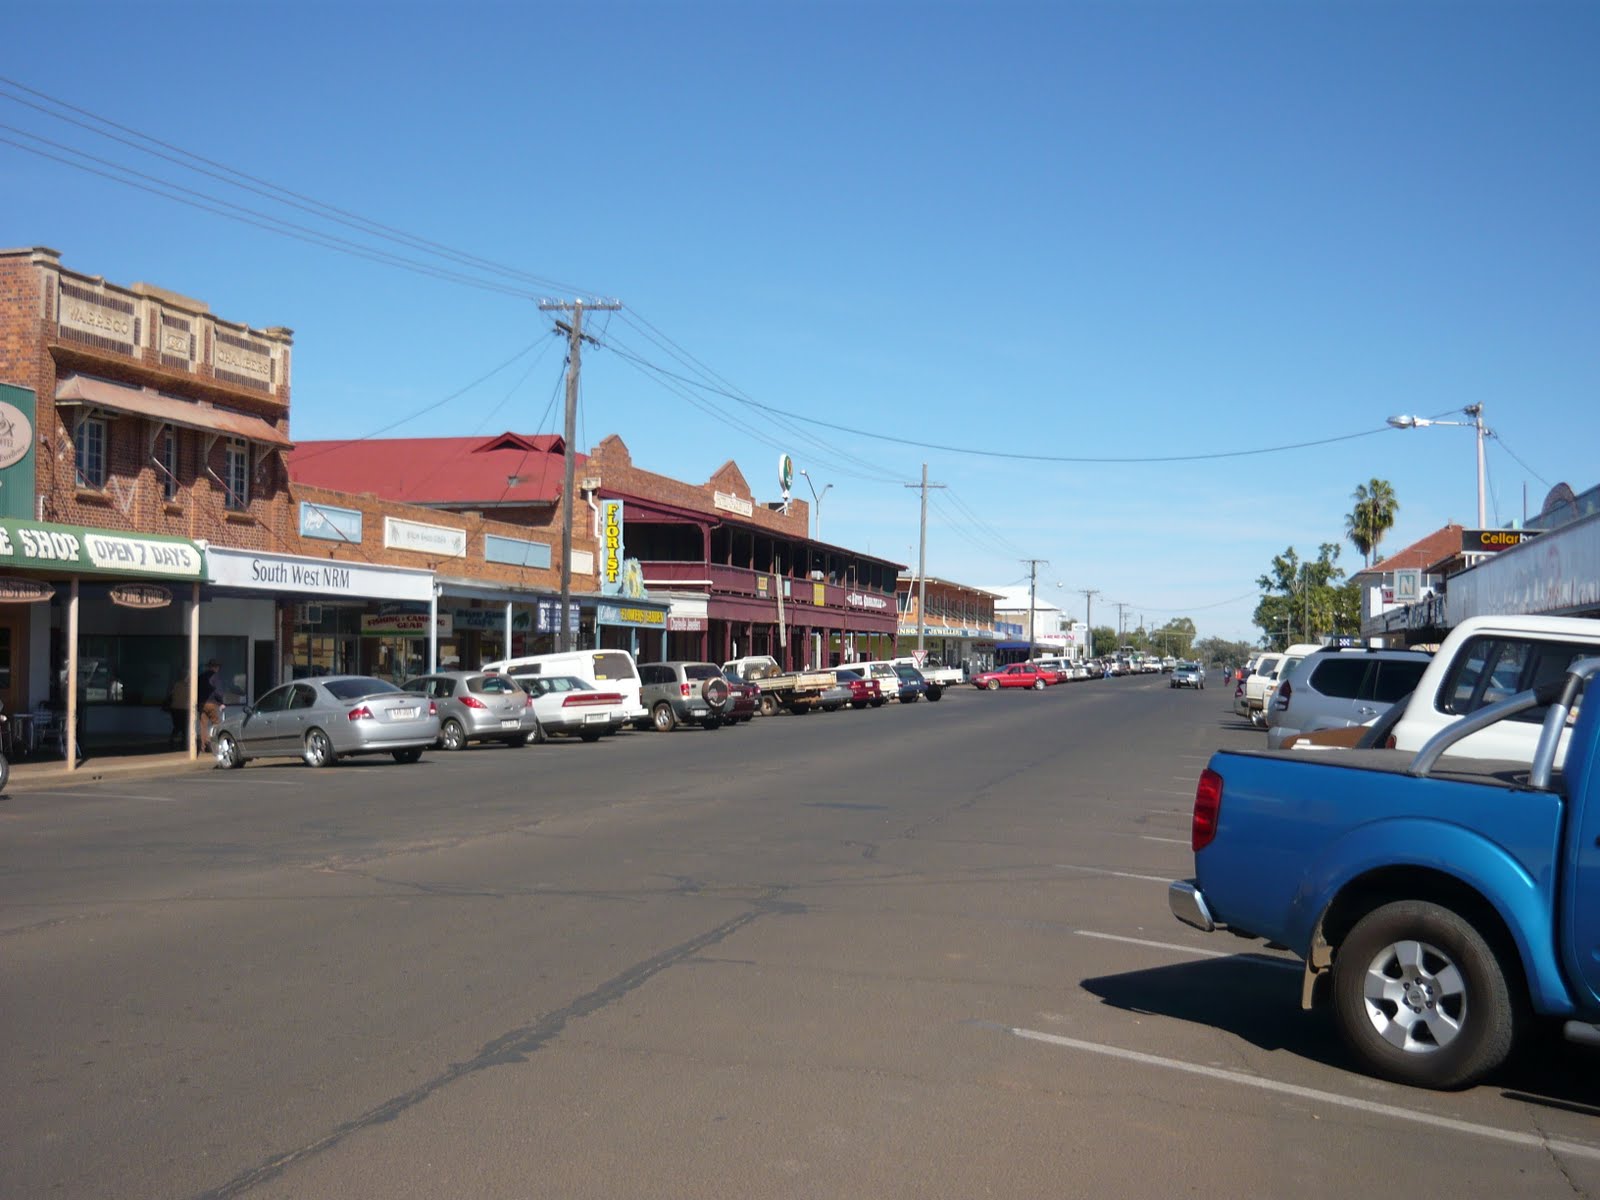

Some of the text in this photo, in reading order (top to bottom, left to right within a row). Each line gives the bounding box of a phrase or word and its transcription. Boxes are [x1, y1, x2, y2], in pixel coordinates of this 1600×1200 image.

[69, 304, 129, 336] WARREGO
[217, 350, 270, 375] CHAMBERS
[18, 528, 81, 561] SHOP
[94, 539, 192, 567] OPEN 7 DAYS
[606, 503, 620, 583] FLORIST
[252, 558, 351, 589] South West NRM
[121, 587, 164, 604] FINE FOOD
[367, 615, 400, 627] FISHING
[396, 622, 423, 630] GEAR
